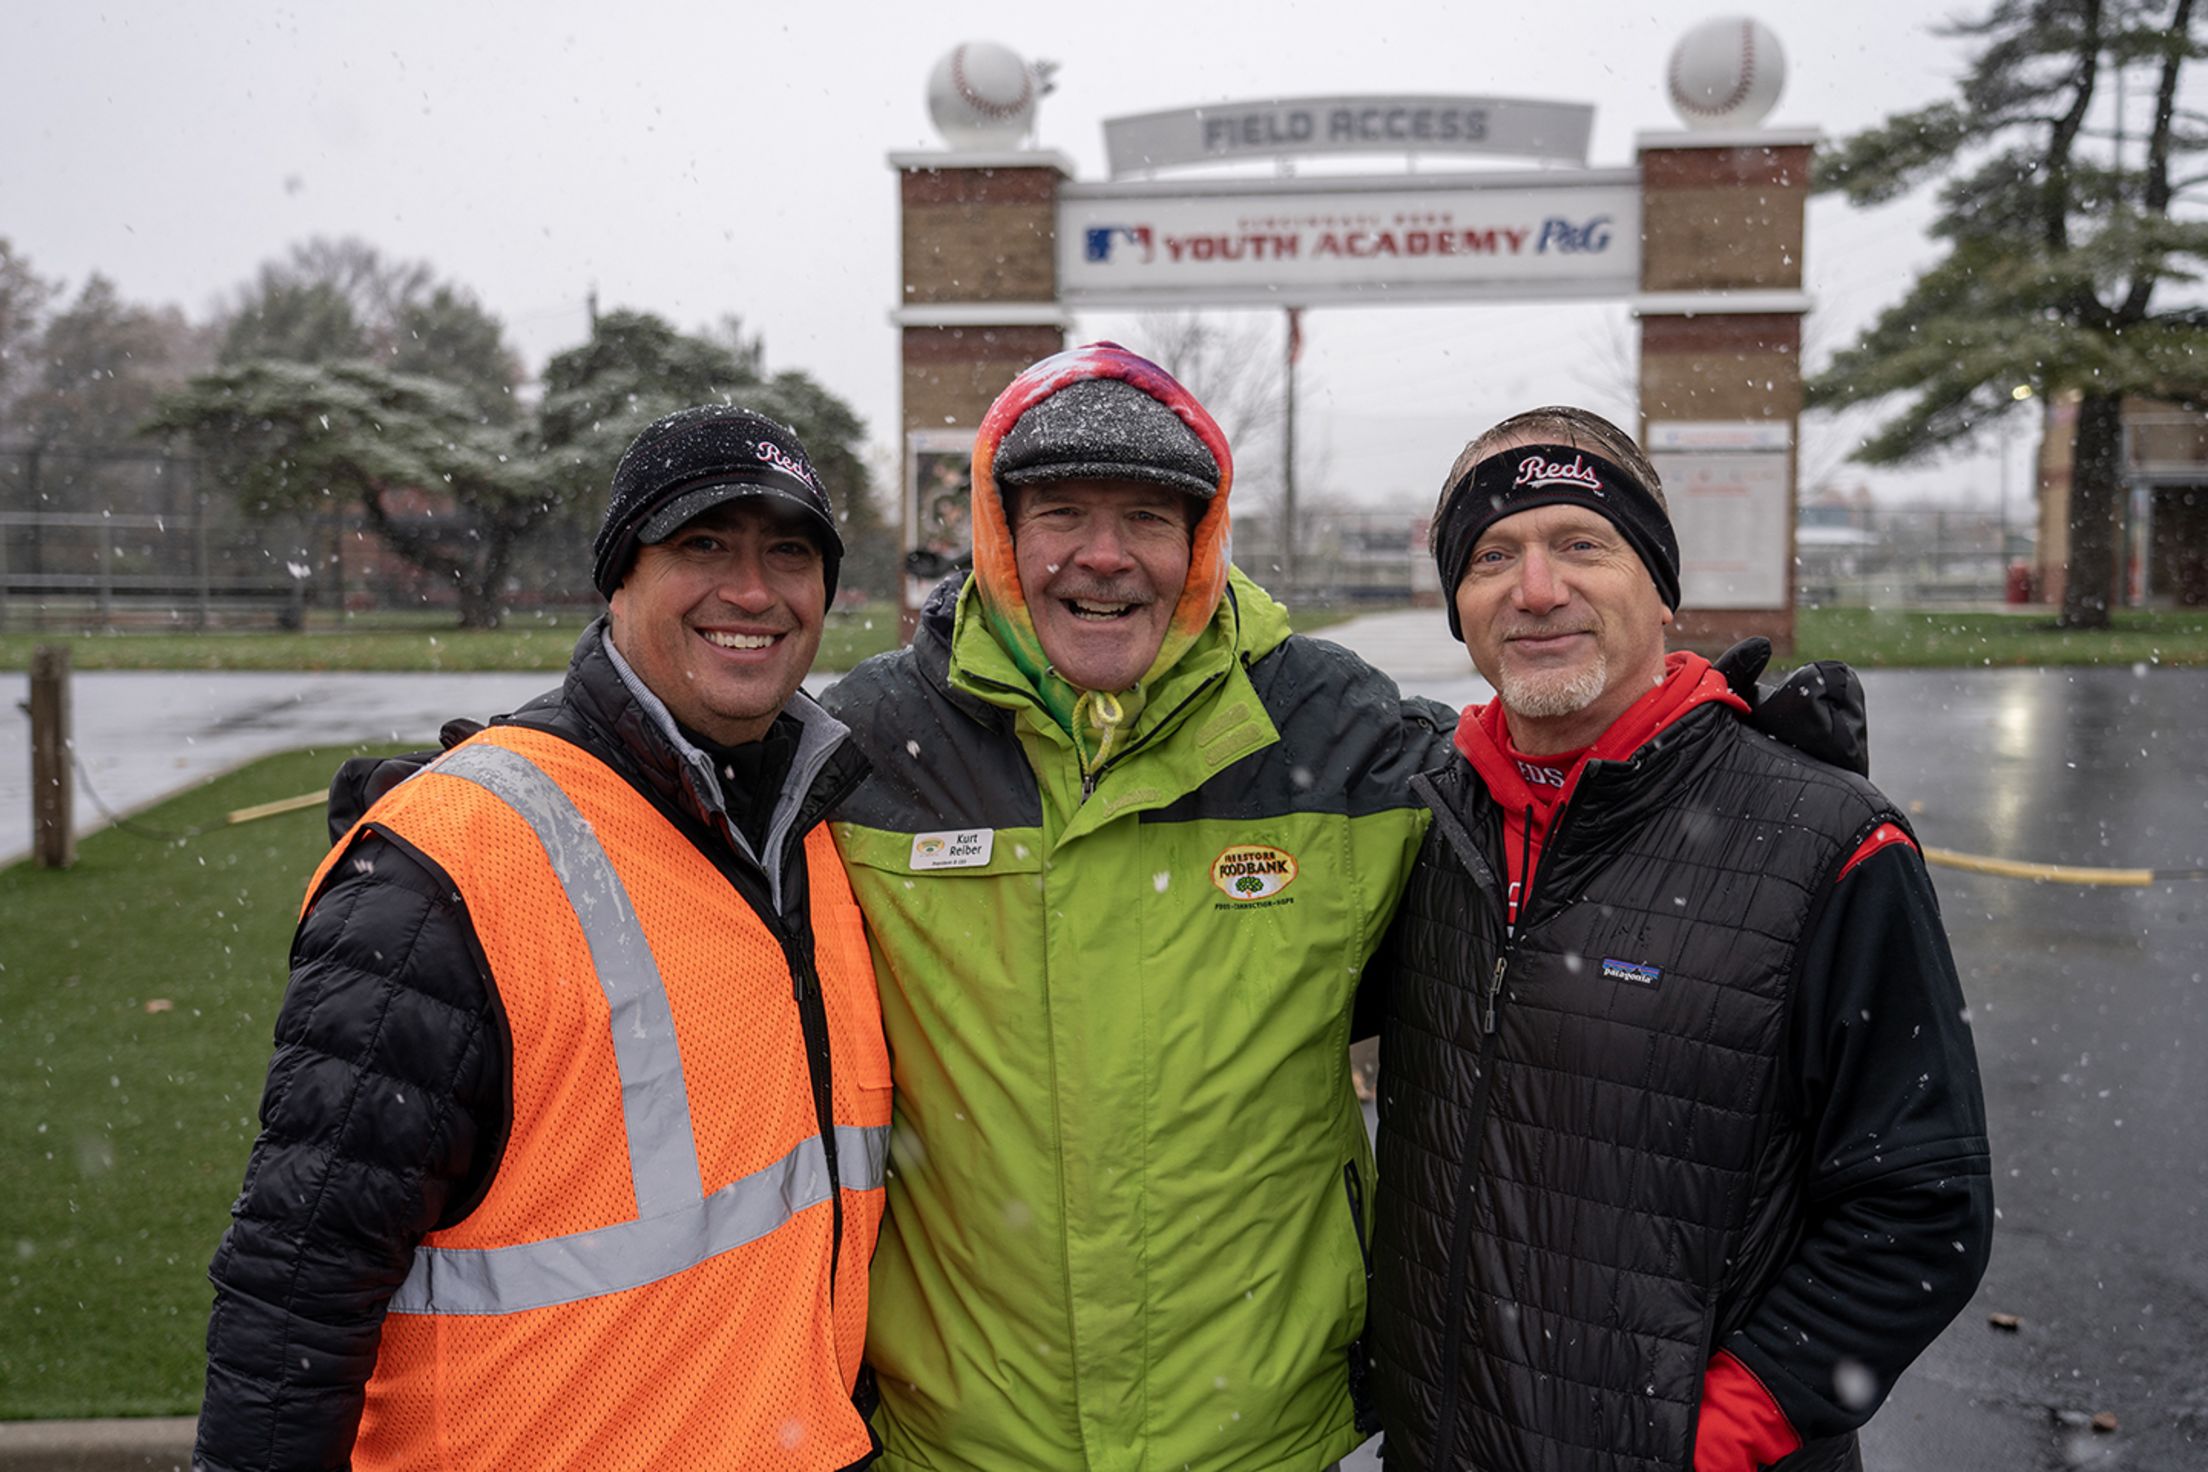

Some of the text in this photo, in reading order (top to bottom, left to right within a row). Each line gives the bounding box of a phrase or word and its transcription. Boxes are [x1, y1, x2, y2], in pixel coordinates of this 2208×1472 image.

[1203, 108, 1488, 148] FIELD ACCESS
[1164, 226, 1528, 262] YOUTH ACADEMY
[1536, 215, 1612, 254] P&G
[756, 441, 818, 494] Reds
[1516, 454, 1604, 489] Reds
[1517, 760, 1565, 788] EDS
[949, 845, 982, 856] Reiber
[957, 833, 978, 844] Kurt
[1219, 860, 1289, 878] FOODBANK
[1603, 967, 1652, 984] patagonia
